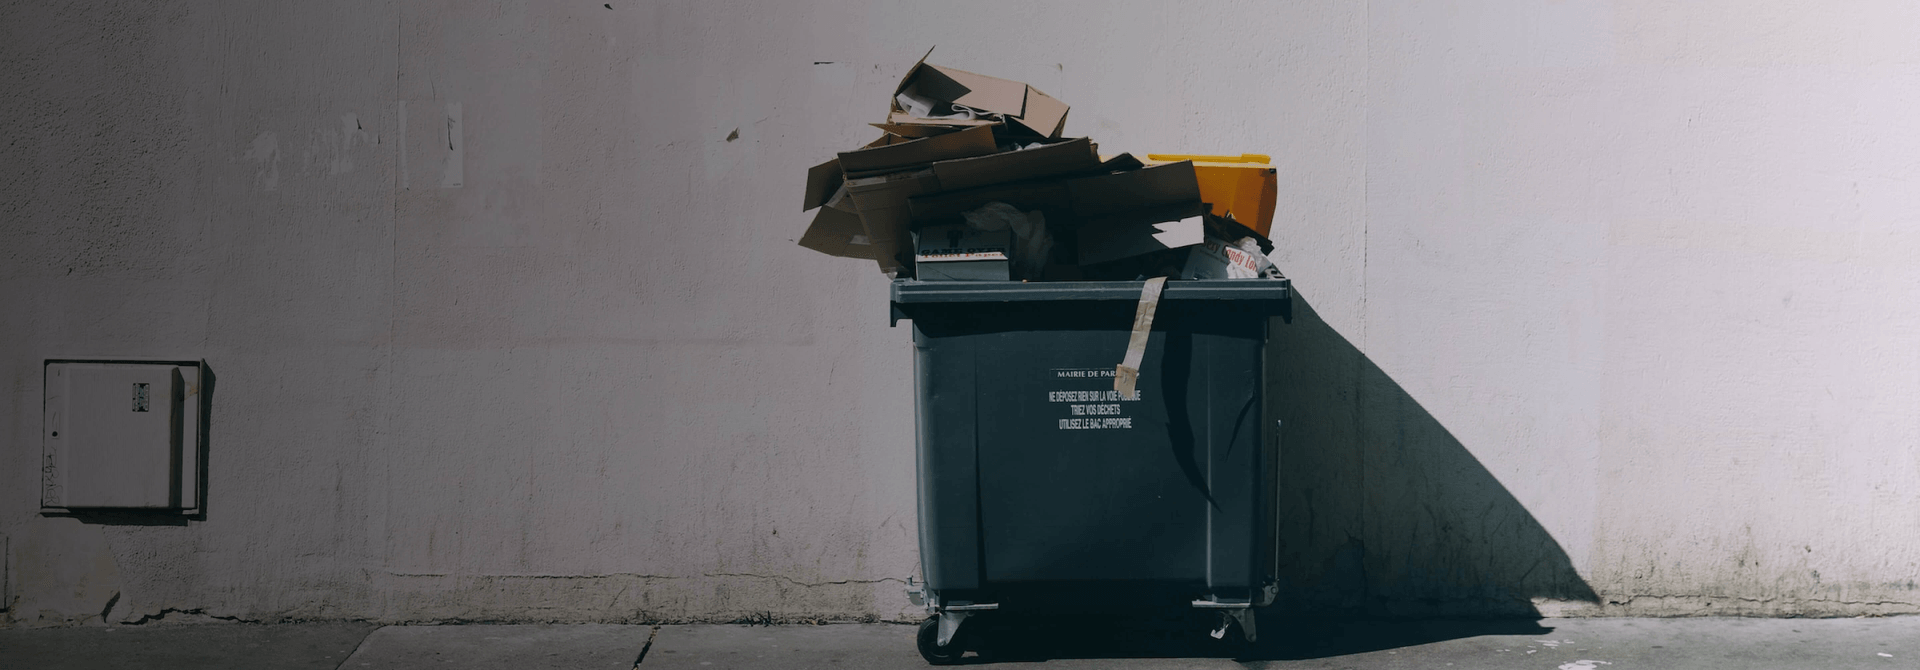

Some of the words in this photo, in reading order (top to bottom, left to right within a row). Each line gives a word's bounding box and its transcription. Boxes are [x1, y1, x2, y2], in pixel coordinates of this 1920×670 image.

[1057, 370, 1086, 378] MAIRIE
[1087, 370, 1099, 378] DE
[1048, 391, 1056, 402] NE
[1056, 389, 1078, 402] DÉPOSEZ
[1078, 391, 1089, 402] RIEN
[1089, 391, 1099, 402] SUR
[1099, 391, 1107, 401] LA
[1106, 390, 1118, 401] VOIE
[1070, 404, 1086, 416] TRIEZ
[1085, 404, 1097, 415] VOS
[1097, 402, 1121, 415] DÉCHETS
[1058, 418, 1082, 430] UTILISEZ
[1082, 418, 1090, 430] LE
[1090, 418, 1101, 429] BAC
[1102, 415, 1132, 429] APPROPRIÉ
